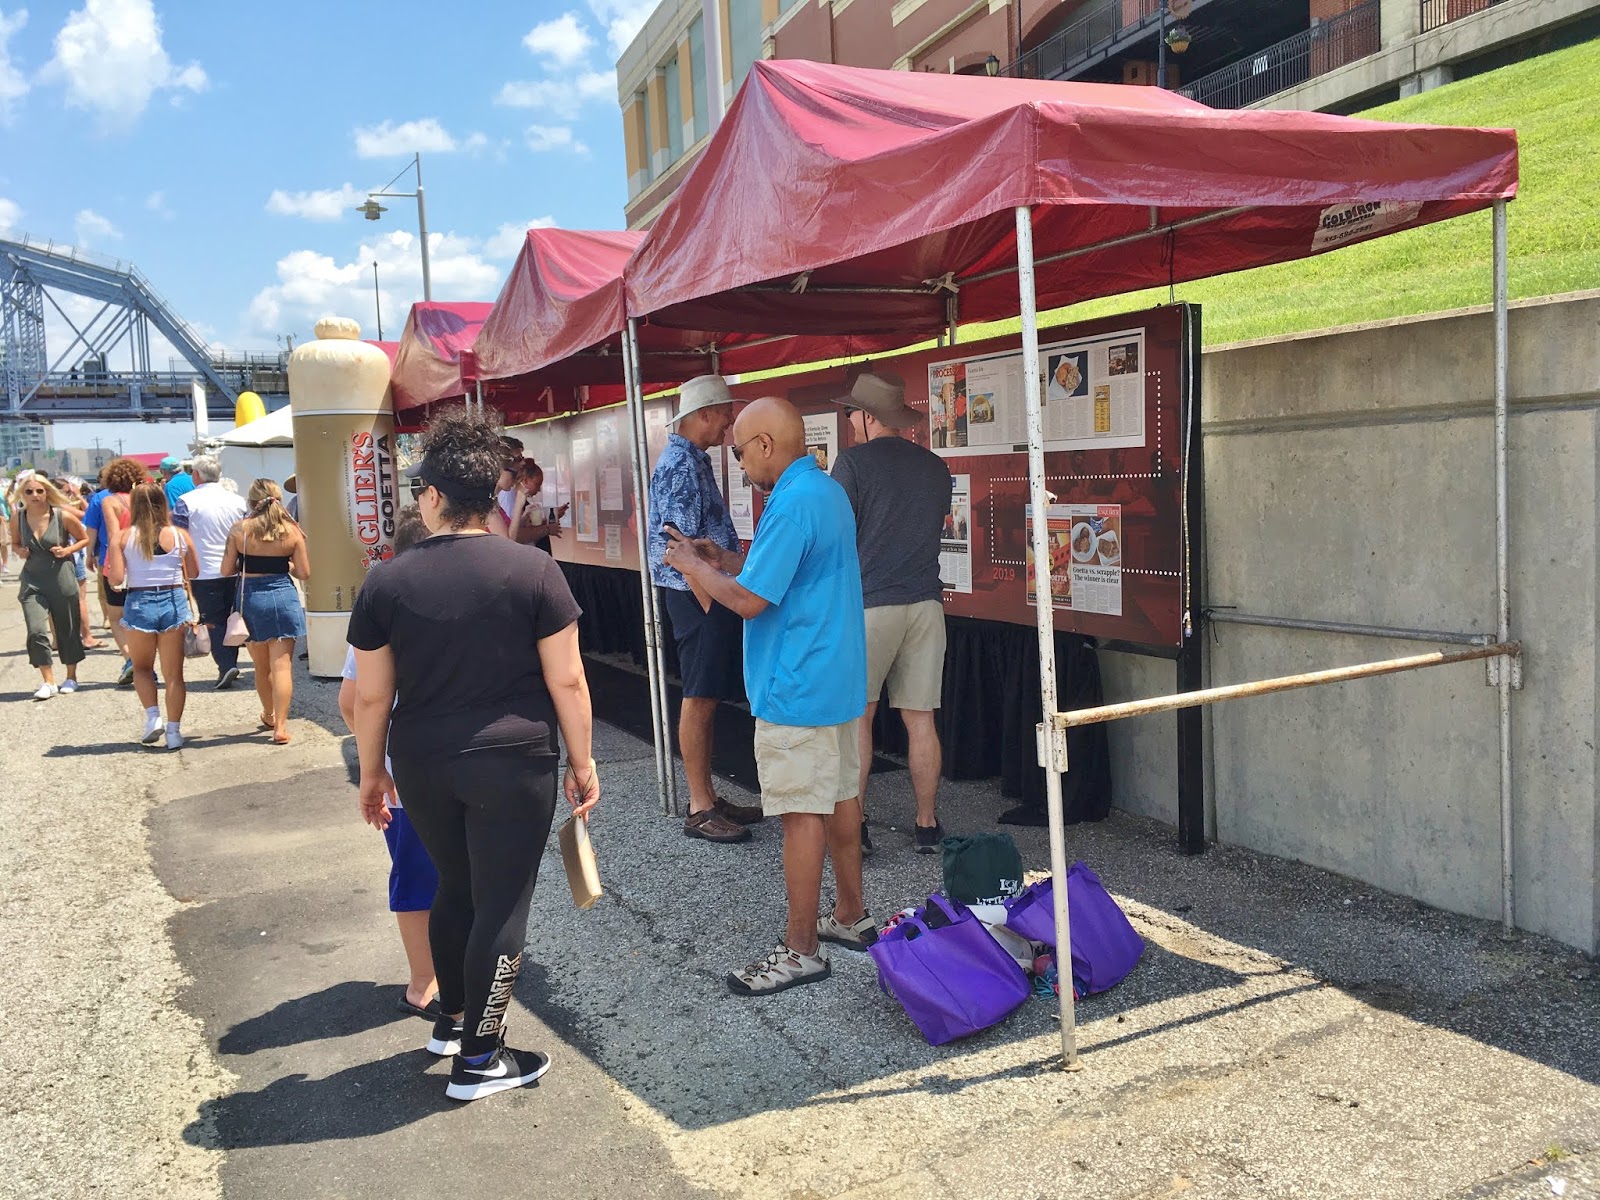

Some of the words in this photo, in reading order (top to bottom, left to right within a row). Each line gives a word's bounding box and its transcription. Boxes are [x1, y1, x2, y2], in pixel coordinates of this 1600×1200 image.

[352, 431, 380, 545] GLIER'S
[377, 433, 395, 539] GOETTA
[992, 567, 1015, 581] 2019
[1072, 566, 1088, 575] Goetta
[1096, 568, 1120, 577] scrapple?
[1074, 573, 1083, 581] The
[1083, 574, 1101, 582] winner
[1101, 575, 1106, 583] is
[1106, 576, 1119, 584] clear
[476, 952, 522, 1036] PINK
